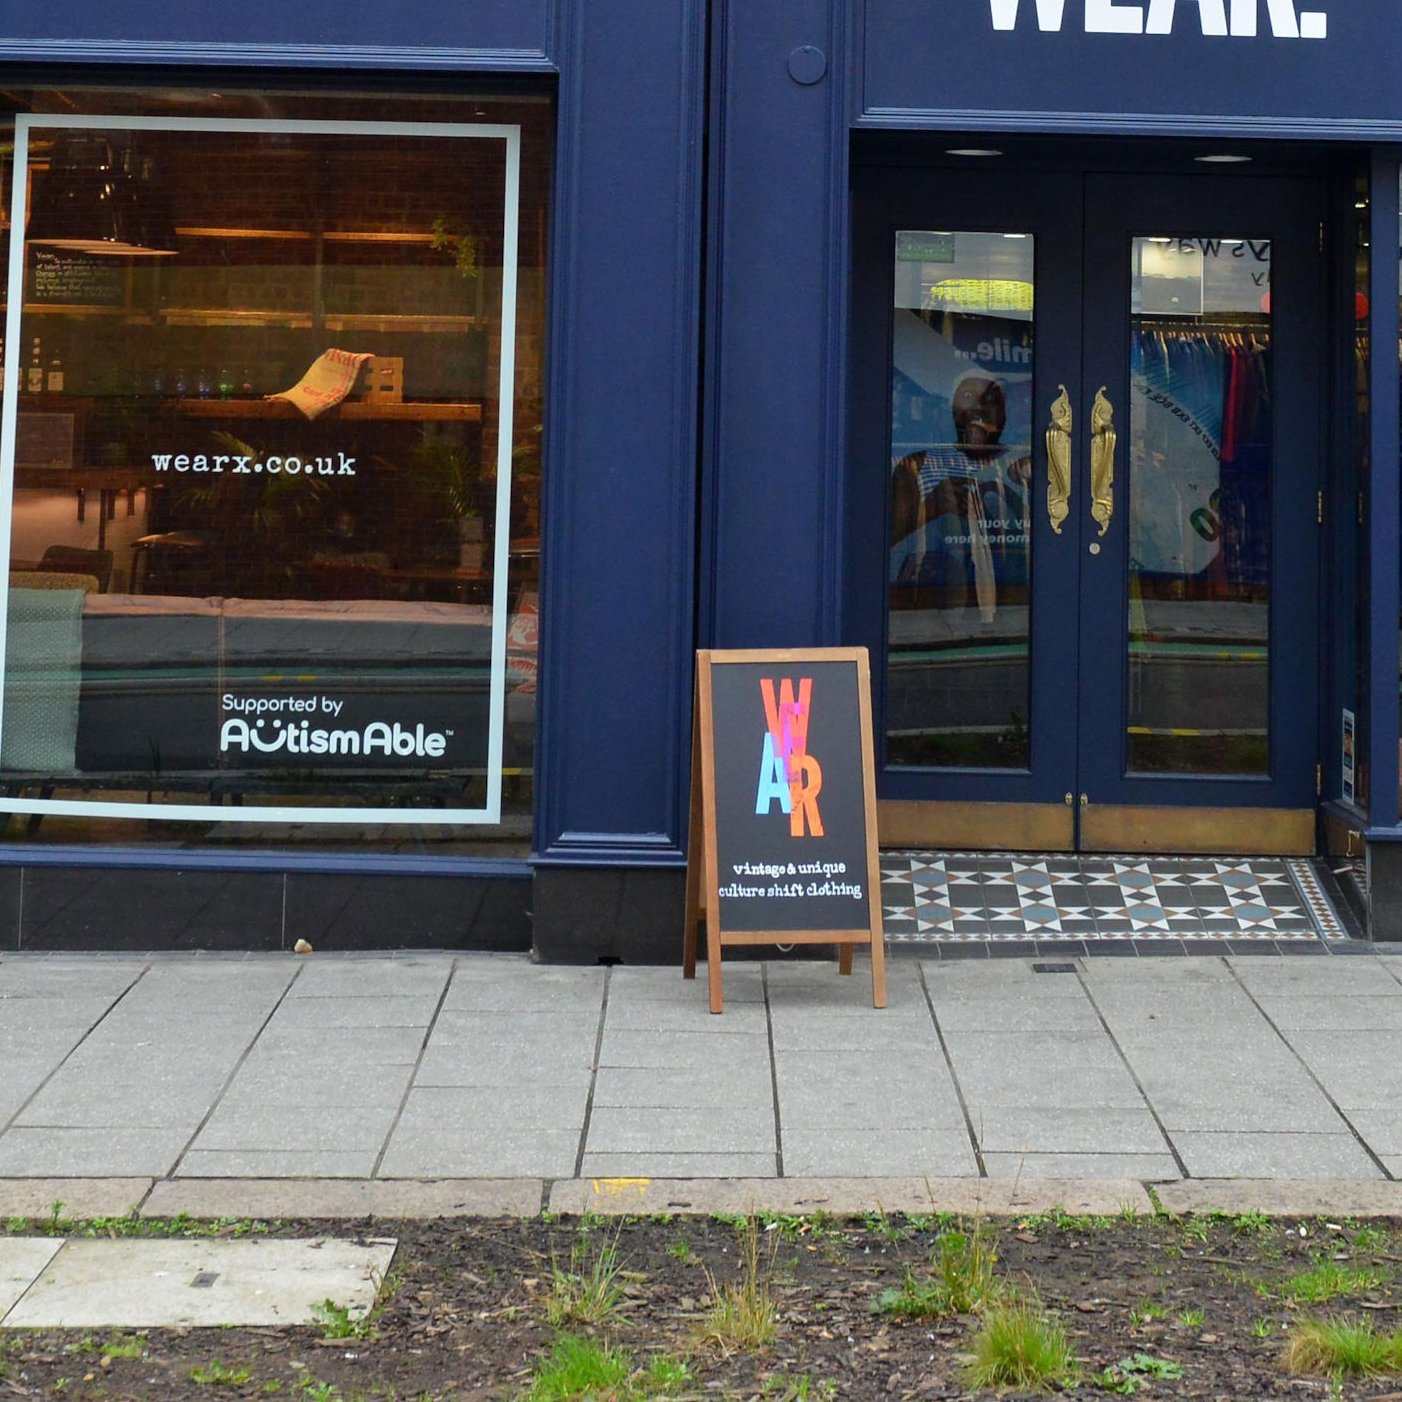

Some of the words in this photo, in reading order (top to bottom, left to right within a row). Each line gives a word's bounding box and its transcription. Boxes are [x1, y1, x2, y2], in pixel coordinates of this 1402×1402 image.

[151, 449, 357, 477] wearx.co.uk
[222, 693, 317, 715] Supported
[321, 696, 344, 717] by
[732, 862, 786, 878] vintage
[786, 862, 797, 875] &
[798, 860, 847, 878] unique
[718, 883, 766, 897] culture
[766, 883, 805, 897] shift
[805, 881, 863, 900] clothing
